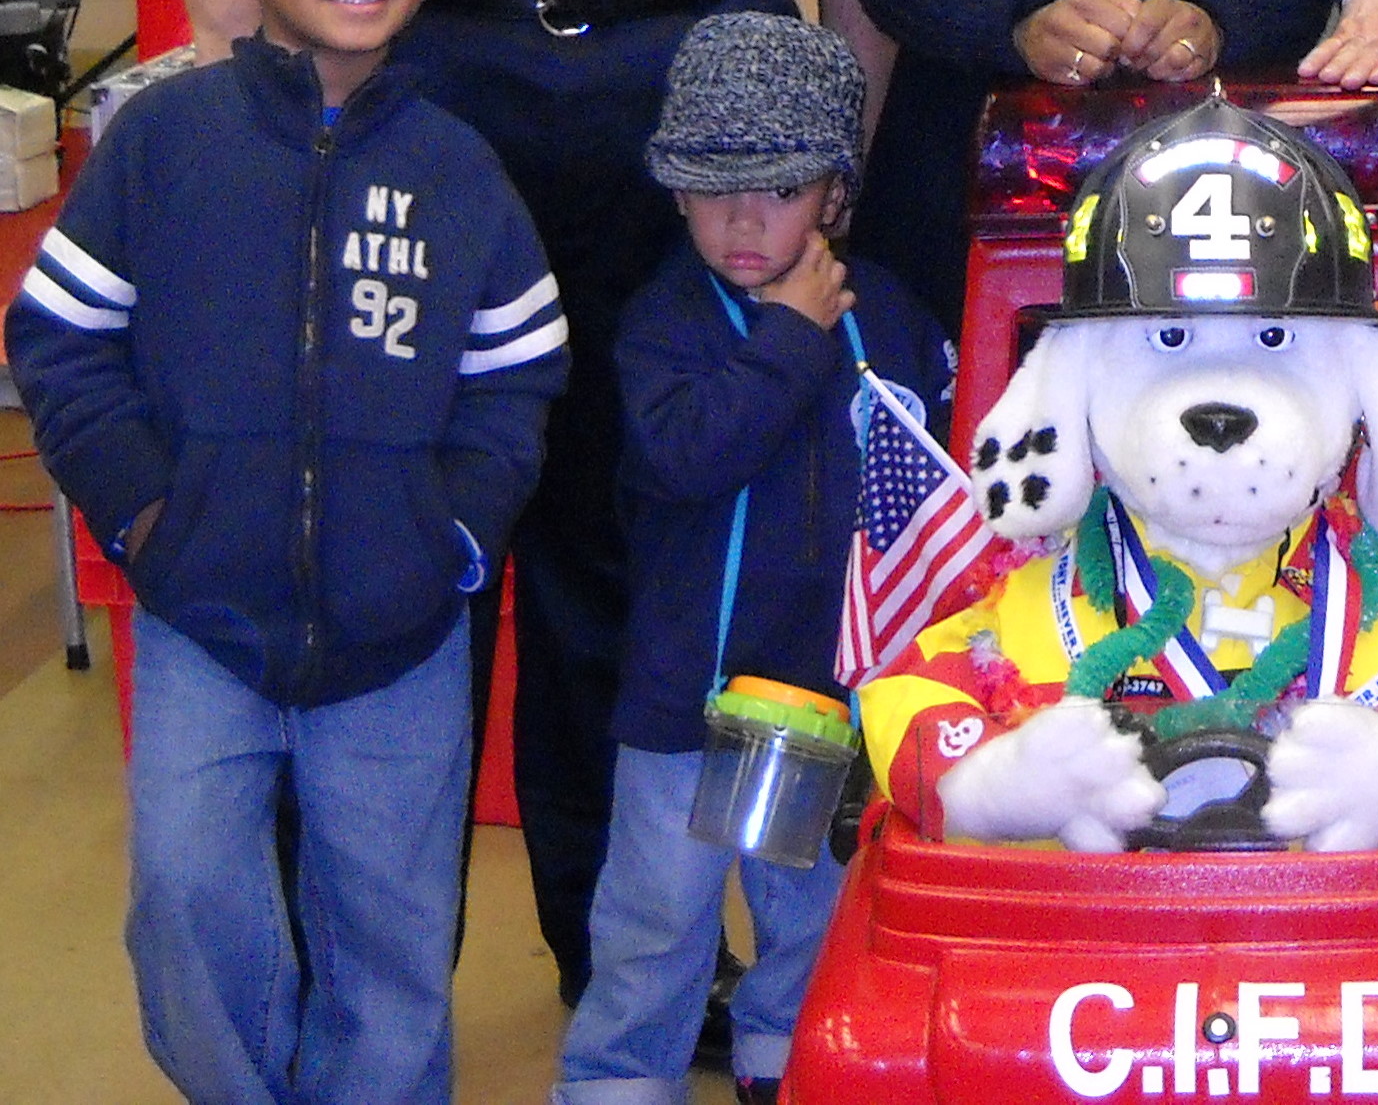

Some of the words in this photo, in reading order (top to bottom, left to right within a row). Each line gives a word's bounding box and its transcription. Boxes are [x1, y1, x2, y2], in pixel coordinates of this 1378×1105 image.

[366, 184, 414, 229] NY
[1171, 173, 1251, 261] 4
[343, 231, 430, 280] ATHL
[350, 277, 419, 360] 92
